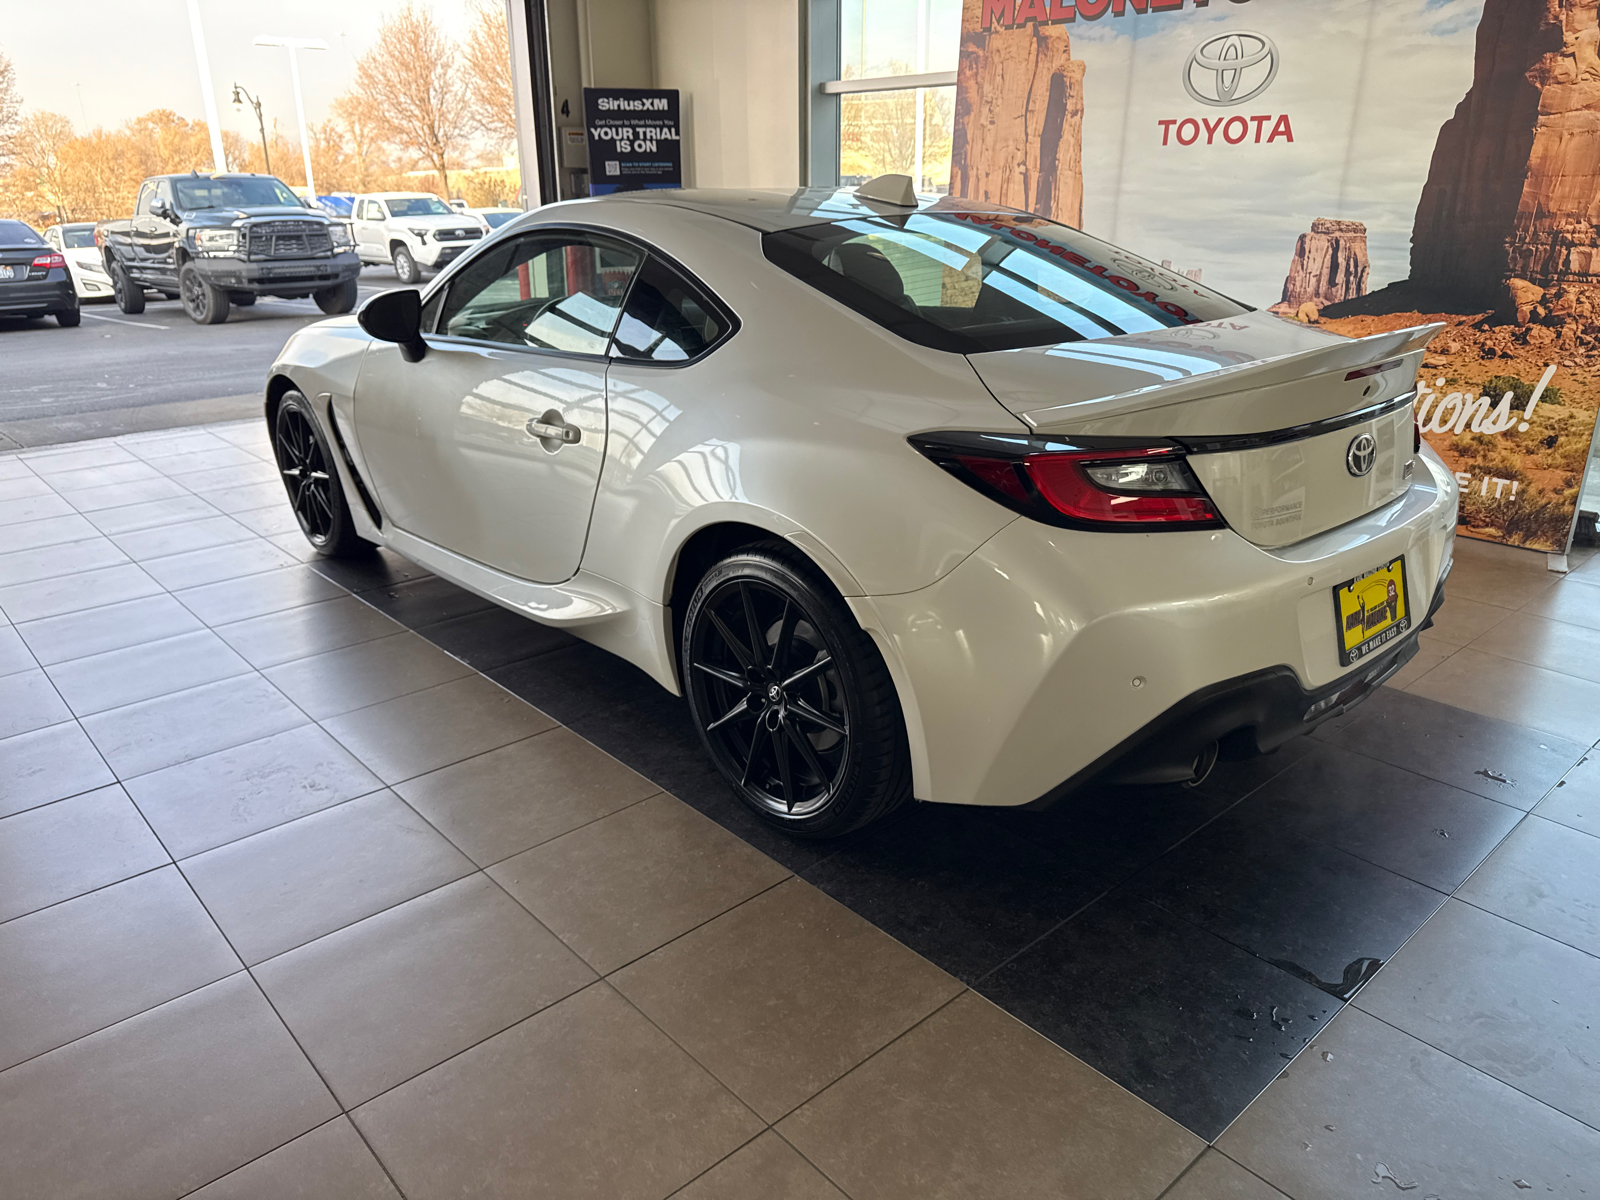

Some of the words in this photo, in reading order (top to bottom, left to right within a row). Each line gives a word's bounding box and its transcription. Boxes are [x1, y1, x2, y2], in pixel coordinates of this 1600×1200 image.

[561, 98, 570, 118] 4
[597, 97, 669, 111] SiriusXM
[595, 118, 605, 126] Get
[606, 118, 623, 126] Closer
[624, 118, 630, 126] to
[630, 118, 645, 126] What
[645, 118, 663, 126] Moves
[664, 118, 674, 126] You
[590, 127, 634, 141] YOUR
[635, 127, 681, 140] TRIAL
[1157, 114, 1295, 147] TOYOTA
[616, 140, 632, 153] IS
[633, 140, 658, 153] ON
[1480, 476, 1519, 501] IT!
[1388, 584, 1395, 597] 32
[1361, 643, 1369, 654] WE
[1369, 636, 1382, 650] MAKE
[1386, 626, 1397, 640] EASY
